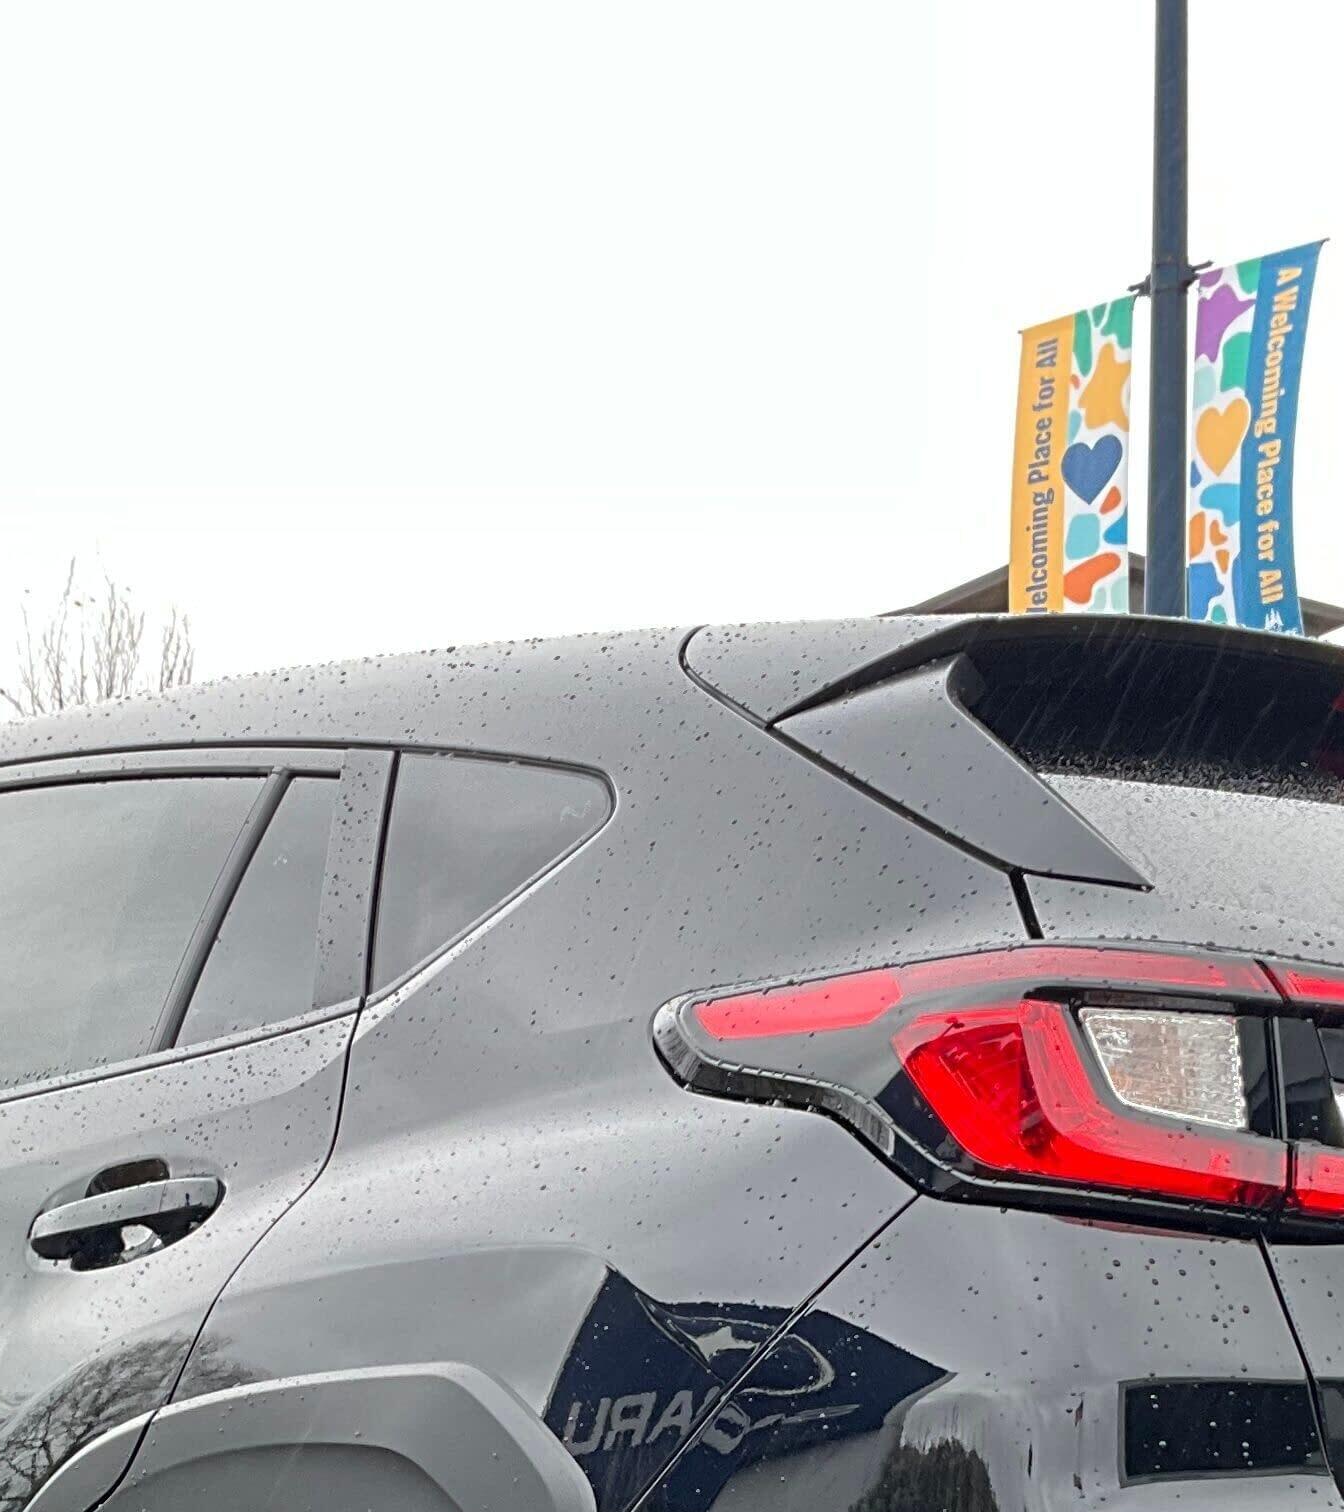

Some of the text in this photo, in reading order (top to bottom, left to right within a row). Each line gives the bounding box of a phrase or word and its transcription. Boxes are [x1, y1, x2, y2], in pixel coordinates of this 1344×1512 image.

[1276, 266, 1303, 287] A
[1254, 285, 1300, 438] Welcoming
[1025, 337, 1058, 613] elcoming Place for All
[1256, 438, 1282, 516] Place
[1258, 519, 1280, 562] for
[1258, 569, 1284, 605] All
